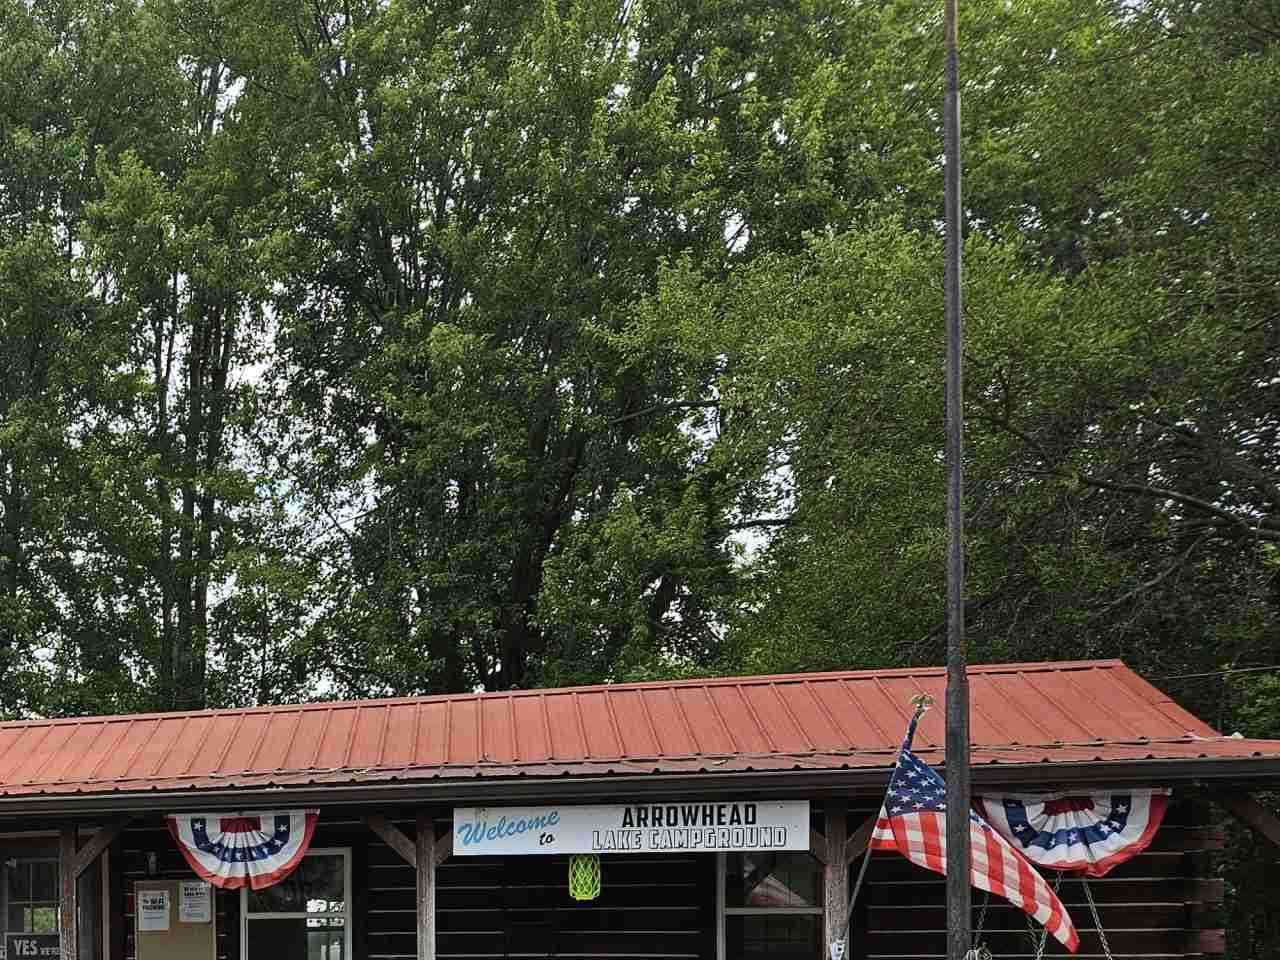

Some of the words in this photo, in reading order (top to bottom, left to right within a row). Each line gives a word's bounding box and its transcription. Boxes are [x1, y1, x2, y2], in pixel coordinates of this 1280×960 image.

[457, 810, 561, 846] Welcome
[622, 803, 757, 828] ARROWHEAD
[539, 831, 554, 846] to
[591, 829, 642, 851] LAKE
[648, 826, 788, 849] CAMPGROUND
[14, 940, 37, 956] YES
